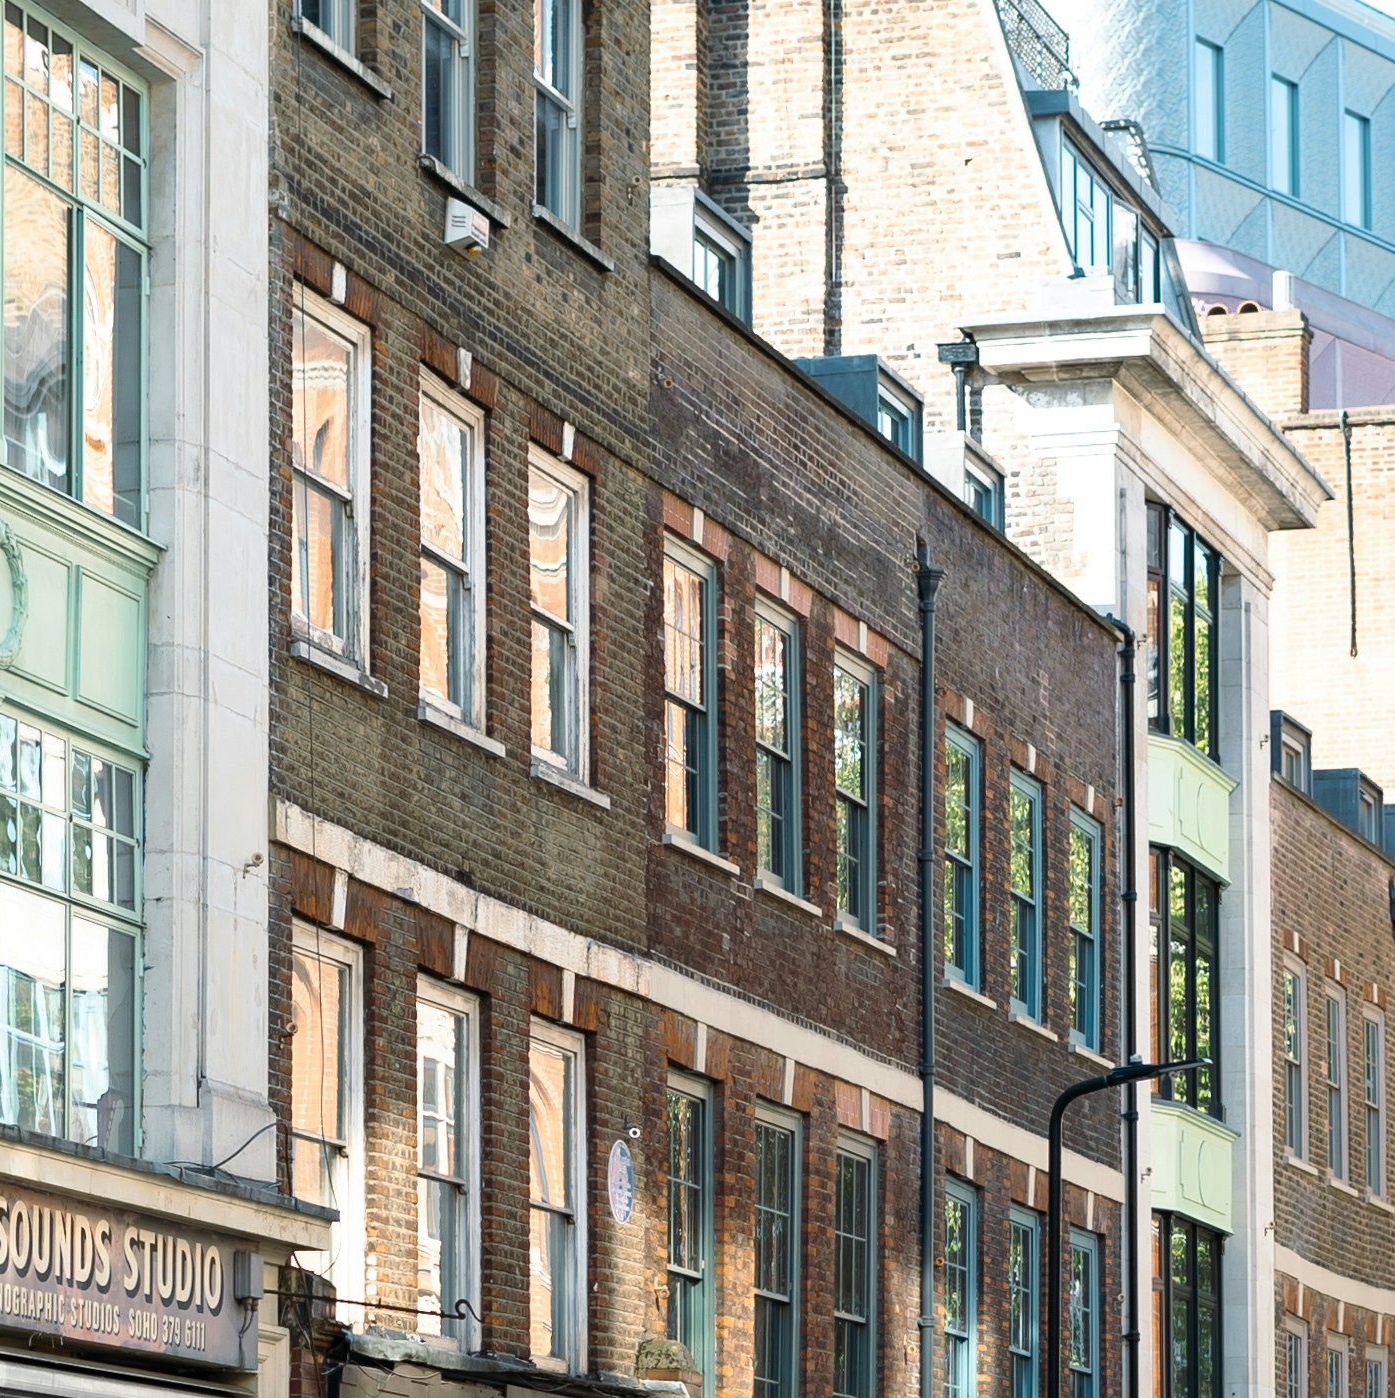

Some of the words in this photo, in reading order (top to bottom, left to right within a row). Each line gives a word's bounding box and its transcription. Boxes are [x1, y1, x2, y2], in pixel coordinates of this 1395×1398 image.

[124, 1226, 223, 1314] STUDIO
[70, 1299, 120, 1335] STUDIOS
[128, 1308, 158, 1342] SOHO
[162, 1315, 181, 1346] 379
[185, 1319, 205, 1352] 6111
